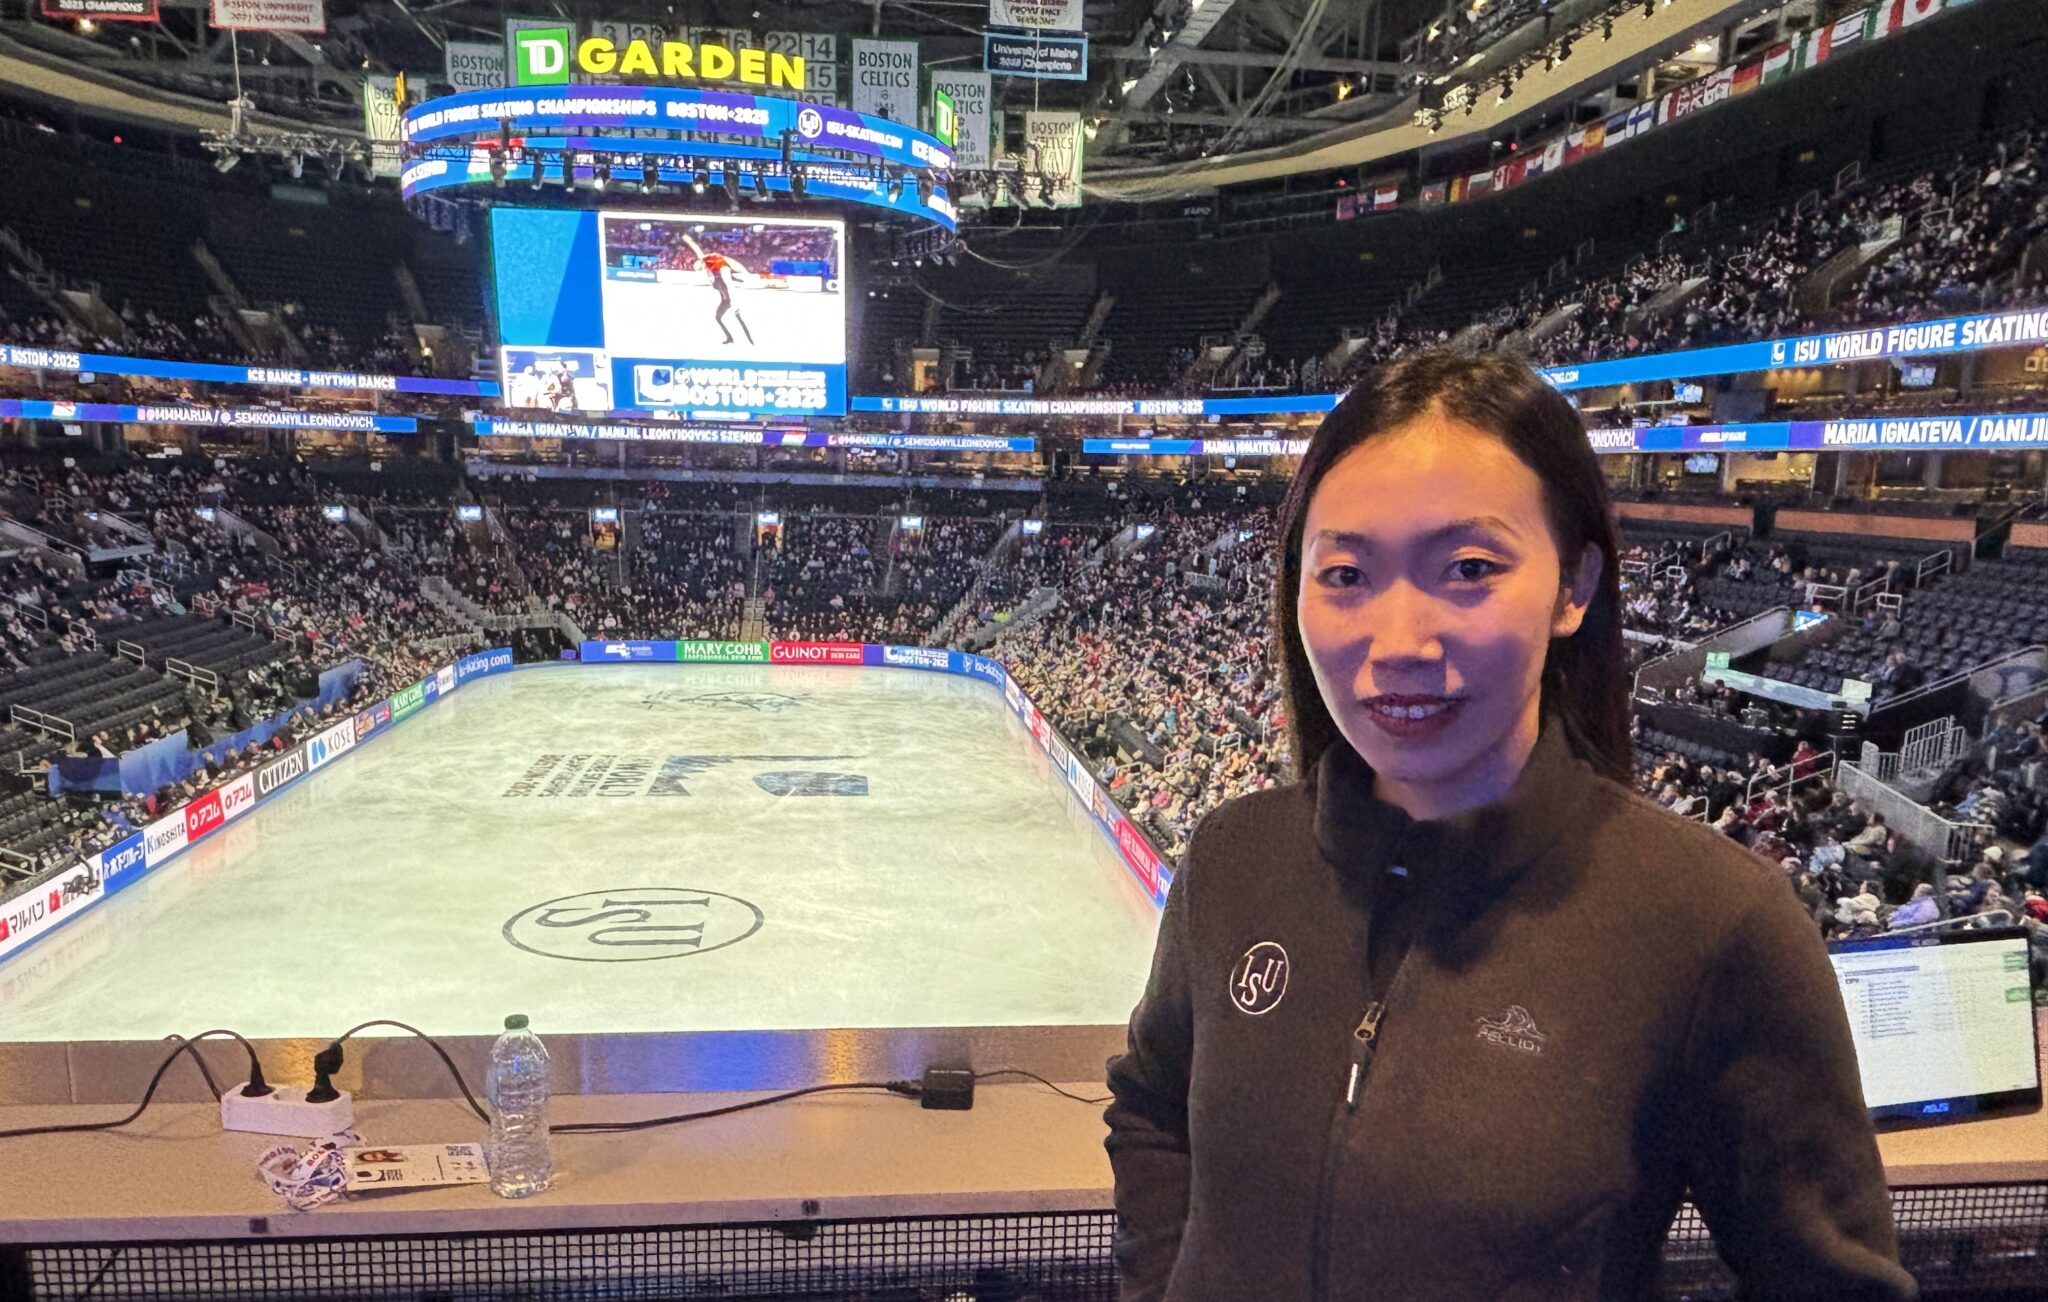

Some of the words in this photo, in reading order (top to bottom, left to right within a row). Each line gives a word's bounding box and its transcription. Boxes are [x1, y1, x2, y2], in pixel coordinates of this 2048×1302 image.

[806, 36, 831, 59] 14
[452, 54, 504, 71] BOSTON
[521, 39, 564, 75] TD
[578, 38, 805, 90] GARDEN
[859, 52, 912, 70] BOSTON
[453, 71, 501, 88] CELTICS
[806, 65, 832, 88] 15
[861, 70, 910, 88] CELTICS
[937, 83, 985, 98] BOSTON
[481, 100, 534, 118] SKATING
[537, 98, 657, 117] CHAMPIONSHIPS
[953, 99, 983, 115] LTICS
[1032, 122, 1074, 135] BOSTON
[1794, 340, 1821, 362] ISU
[1825, 332, 1883, 359] WORLD
[1886, 323, 1957, 352] FIGURE
[1960, 311, 2048, 346] SKATING
[248, 368, 266, 382] ICE
[266, 369, 301, 384] DANCE
[309, 372, 357, 387] RHYTHM
[358, 375, 396, 390] DANCE
[921, 400, 959, 412] WORLD
[961, 400, 1000, 412] FIGURE
[1003, 400, 1049, 414] SKATING
[1050, 401, 1134, 414] CHAMPIONSHIPS
[1823, 422, 1878, 444] MARIIA
[1880, 420, 1962, 444] IGNATEVA
[685, 642, 723, 655] MARY
[725, 643, 763, 656] COHR
[773, 645, 829, 659] GUINOT
[259, 749, 303, 795] CITIZEN
[9, 899, 45, 934] マルハン
[1237, 955, 1284, 1006] ISU
